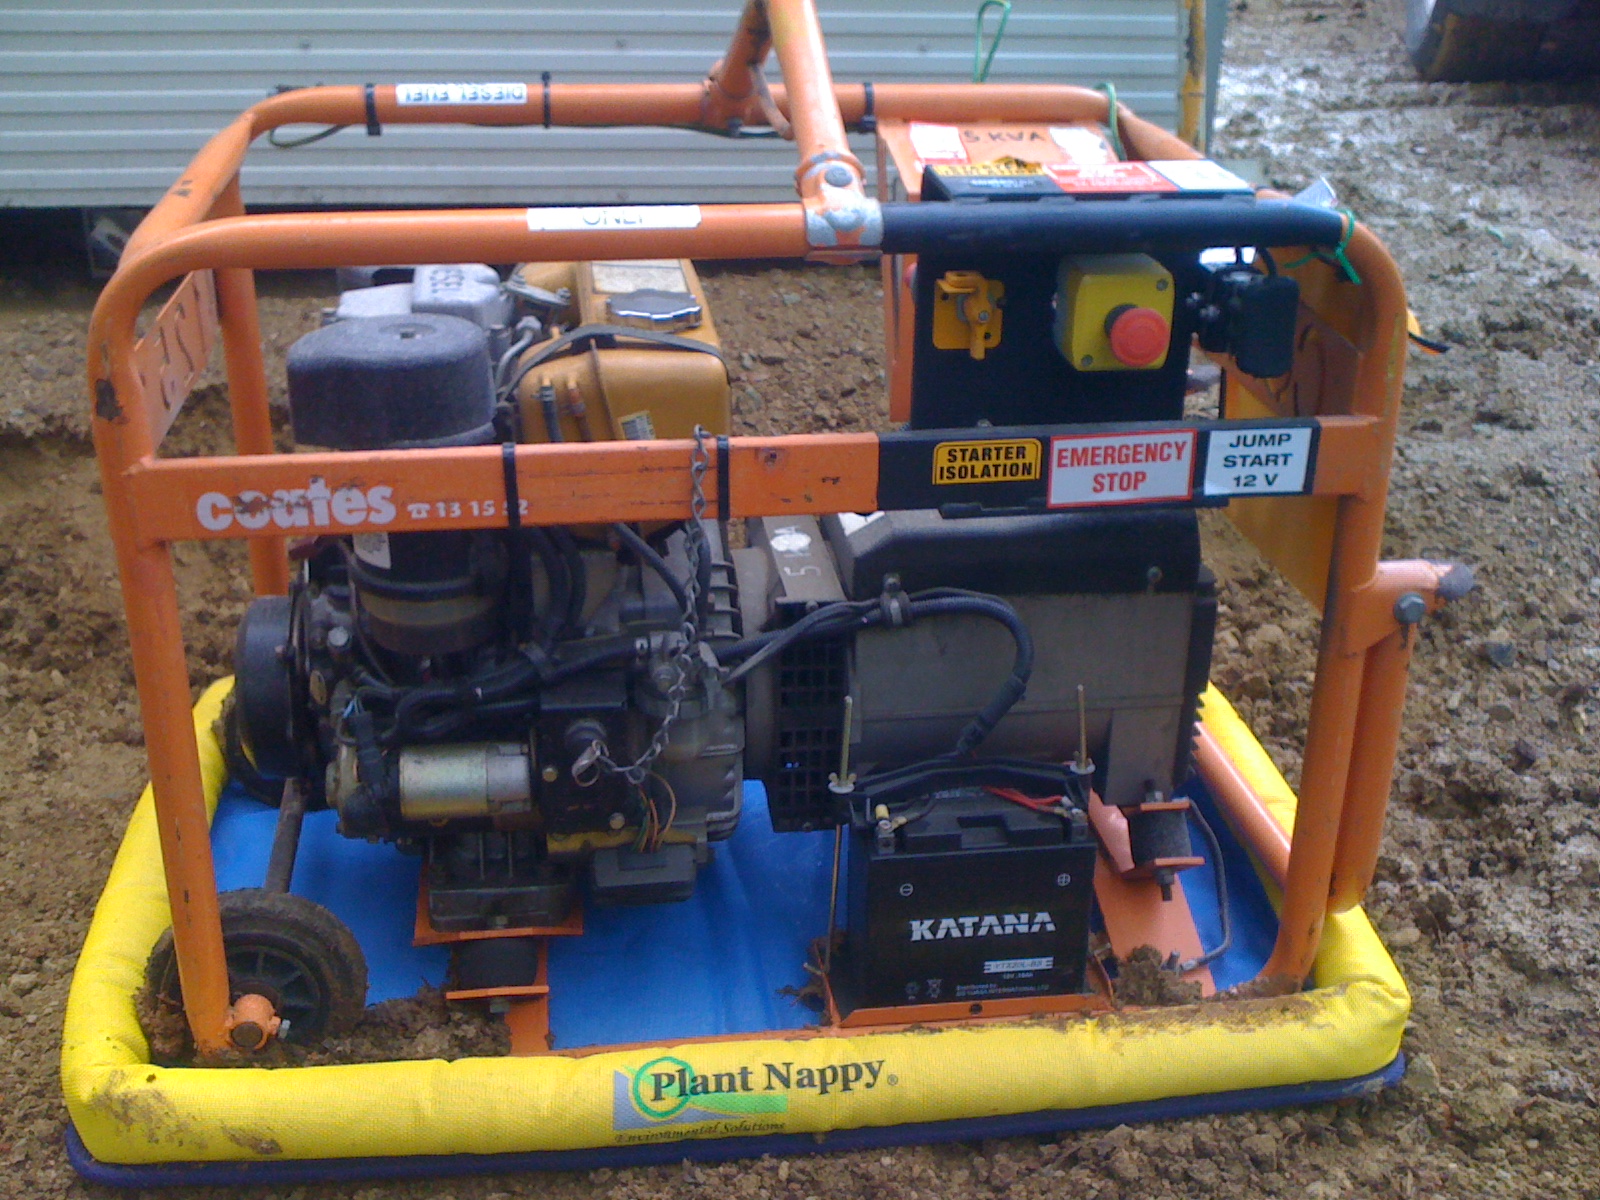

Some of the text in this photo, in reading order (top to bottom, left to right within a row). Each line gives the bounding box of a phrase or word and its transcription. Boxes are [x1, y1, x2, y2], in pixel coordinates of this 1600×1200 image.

[1229, 432, 1292, 449] JUMP
[946, 445, 1027, 464] STARTER
[1056, 440, 1188, 469] EMERGENCY
[1222, 452, 1294, 469] START
[938, 462, 1033, 481] ISOLATION
[1091, 470, 1147, 493] STOP
[1232, 473, 1279, 488] 12 V
[195, 476, 397, 531] coates
[435, 501, 462, 518] 13
[469, 500, 496, 517] 15
[909, 911, 1057, 942] KATANA
[650, 1059, 886, 1102] Plant Nappy
[614, 1119, 787, 1144] Environmental Solutions
